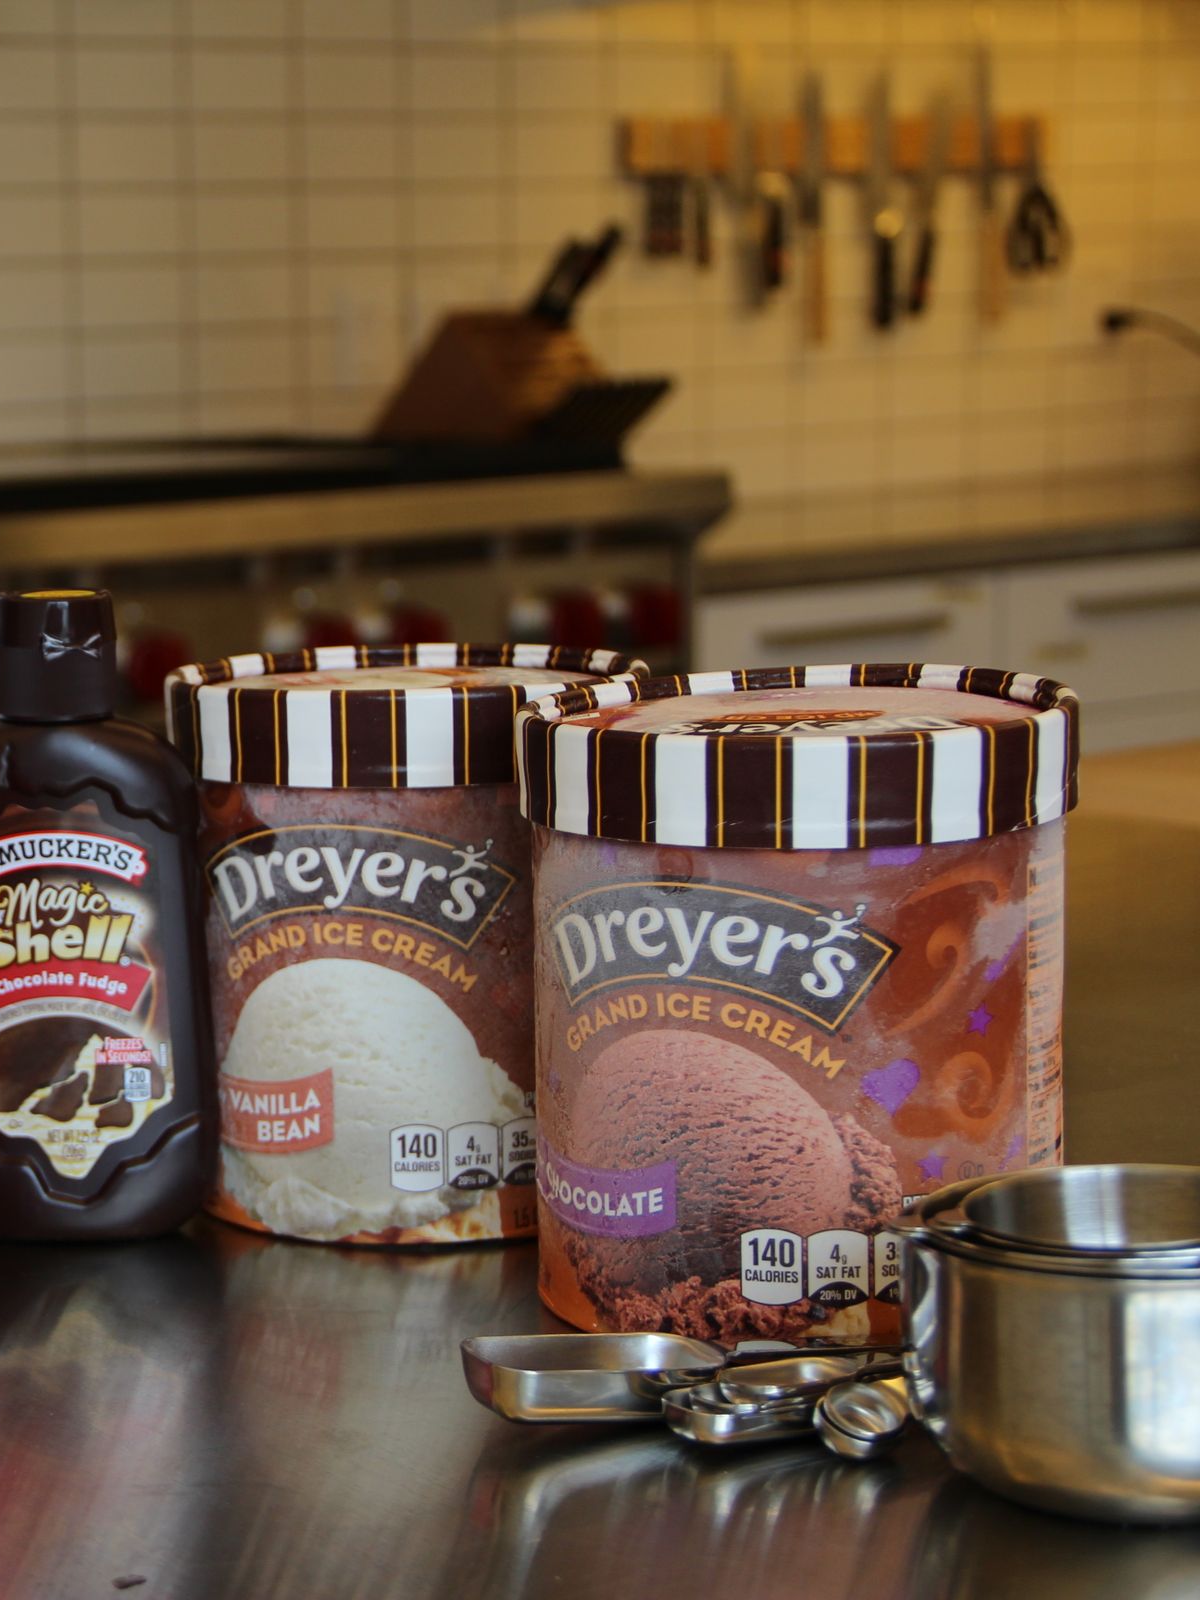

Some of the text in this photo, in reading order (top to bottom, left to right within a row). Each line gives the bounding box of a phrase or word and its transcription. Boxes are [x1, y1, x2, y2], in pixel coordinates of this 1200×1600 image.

[213, 843, 486, 922] Dreyer's
[227, 922, 479, 992] GRAND ICE CREAM
[554, 902, 857, 999] Dreyer's
[79, 972, 128, 994] Fudge
[566, 992, 846, 1078] GRAND ICE CREAM
[229, 1088, 320, 1115] VANILLA
[256, 1114, 321, 1142] BEAN
[397, 1133, 437, 1158] 140
[394, 1161, 441, 1172] CALORIES
[455, 1154, 492, 1166] SAT FAT
[546, 1162, 664, 1216] CHOCOLATE
[748, 1237, 795, 1267] 140
[745, 1269, 799, 1283] CALORIES
[816, 1266, 861, 1279] SAT FAT
[820, 1289, 857, 1300] 20% DV
